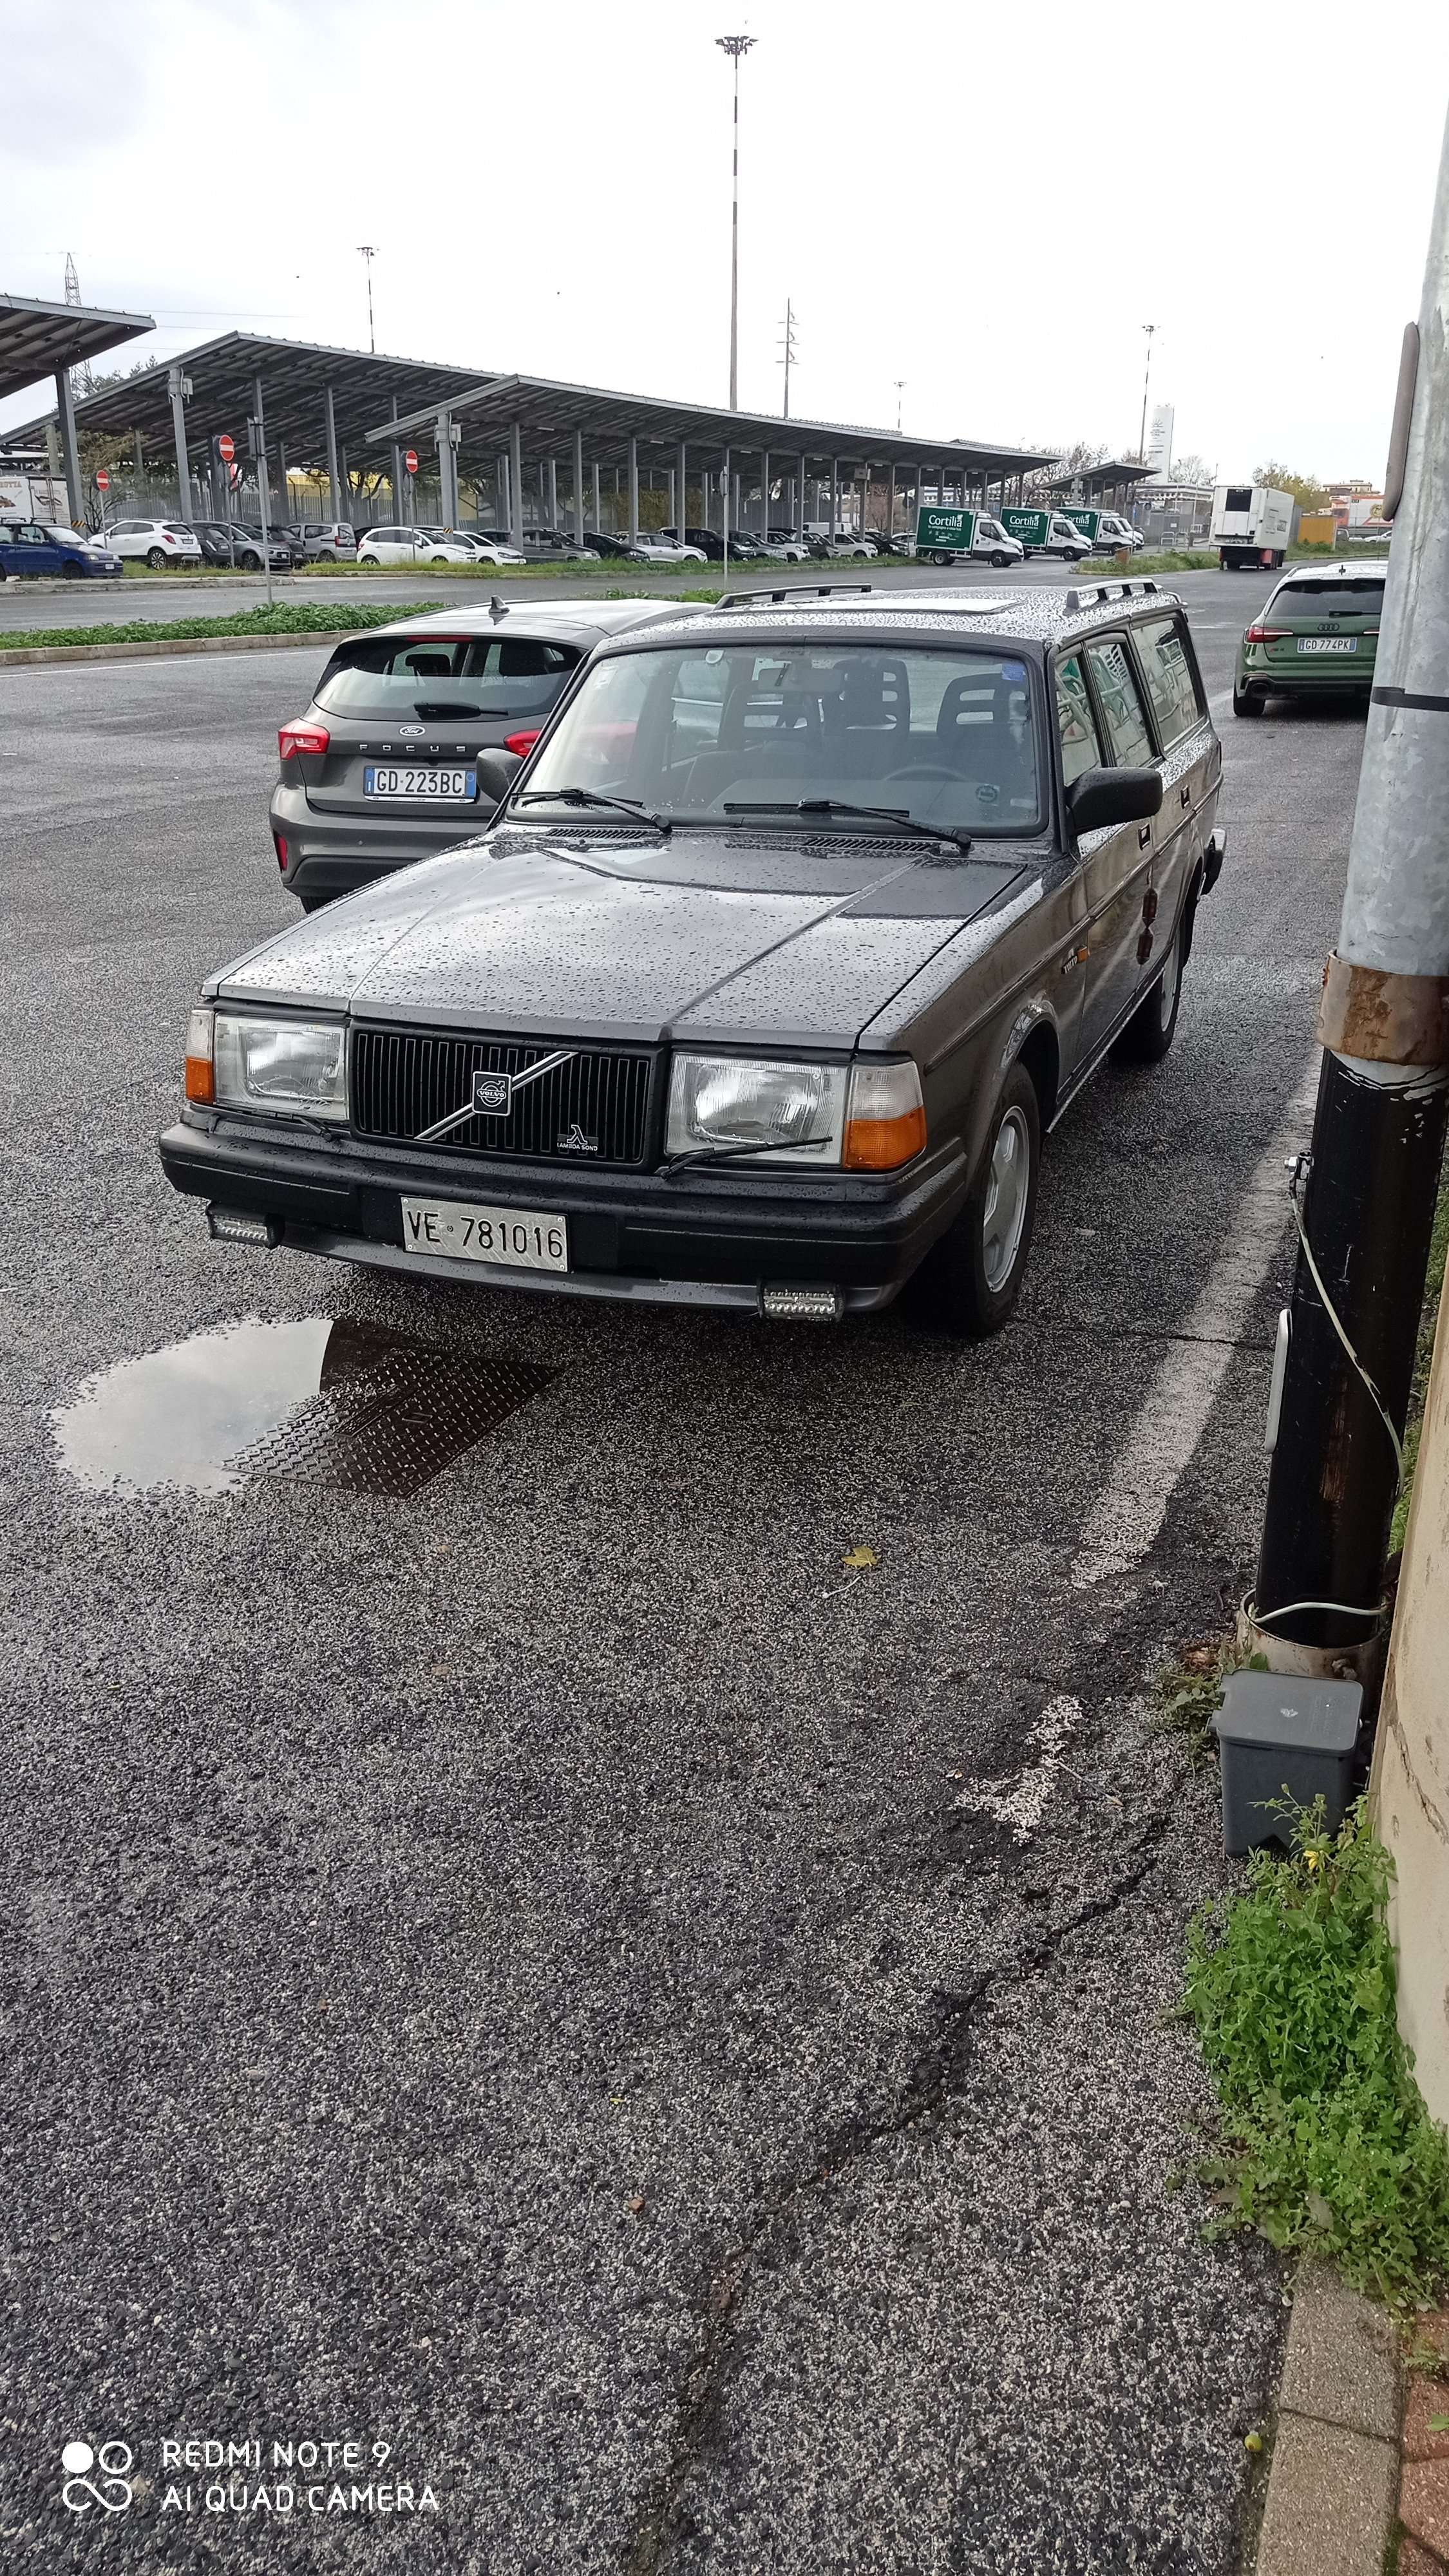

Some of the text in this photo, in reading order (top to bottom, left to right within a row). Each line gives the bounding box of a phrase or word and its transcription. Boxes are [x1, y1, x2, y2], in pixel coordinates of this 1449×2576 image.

[929, 515, 962, 527] Cortilia
[1010, 515, 1039, 526] Cortilia
[1305, 640, 1349, 650] GD 774PK
[359, 744, 466, 752] FOCUS
[377, 770, 462, 793] GD 223BC
[407, 1211, 562, 1258] VE 781016
